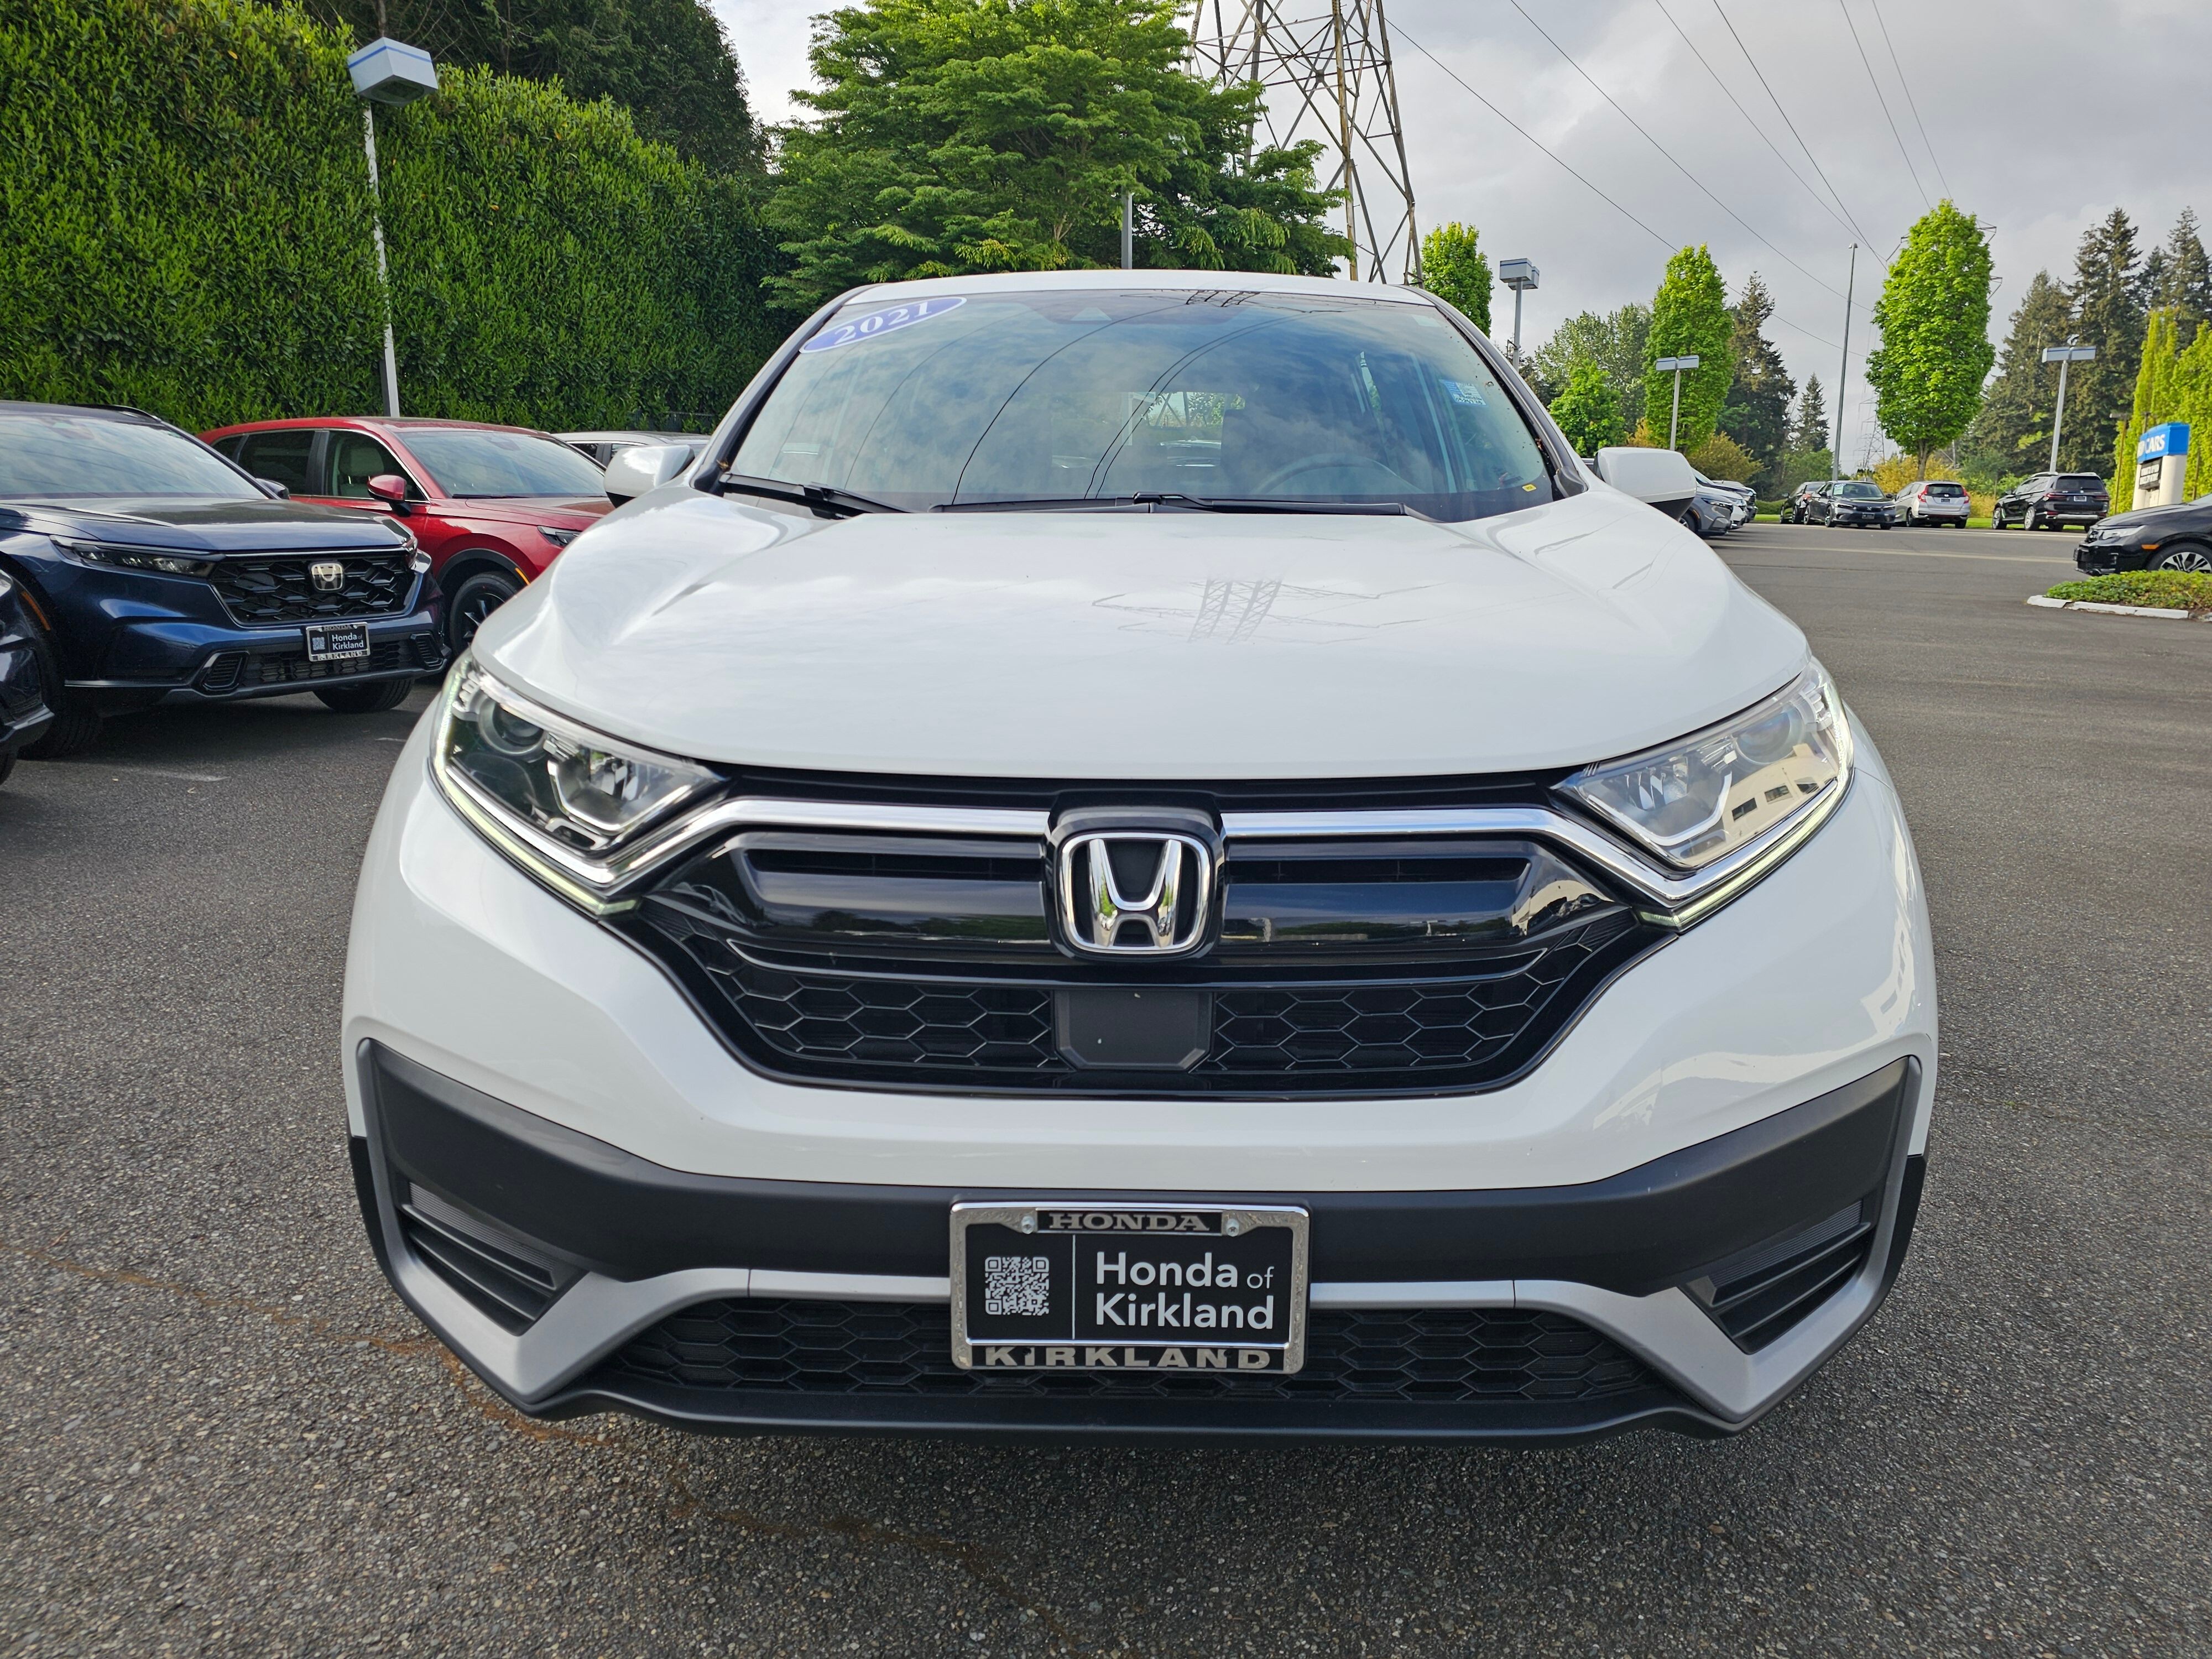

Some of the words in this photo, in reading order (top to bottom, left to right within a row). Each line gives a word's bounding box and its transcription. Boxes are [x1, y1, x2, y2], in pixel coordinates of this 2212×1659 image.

[834, 301, 932, 346] 2021
[2145, 434, 2166, 454] CARS
[332, 633, 357, 642] Honda
[332, 640, 364, 650] Kirkland
[1048, 1213, 1210, 1232] HONDA
[1096, 1251, 1239, 1288] Honda
[1246, 1266, 1275, 1290] of
[1095, 1292, 1274, 1330] Kirkland
[985, 1347, 1271, 1370] KIRKLAND
